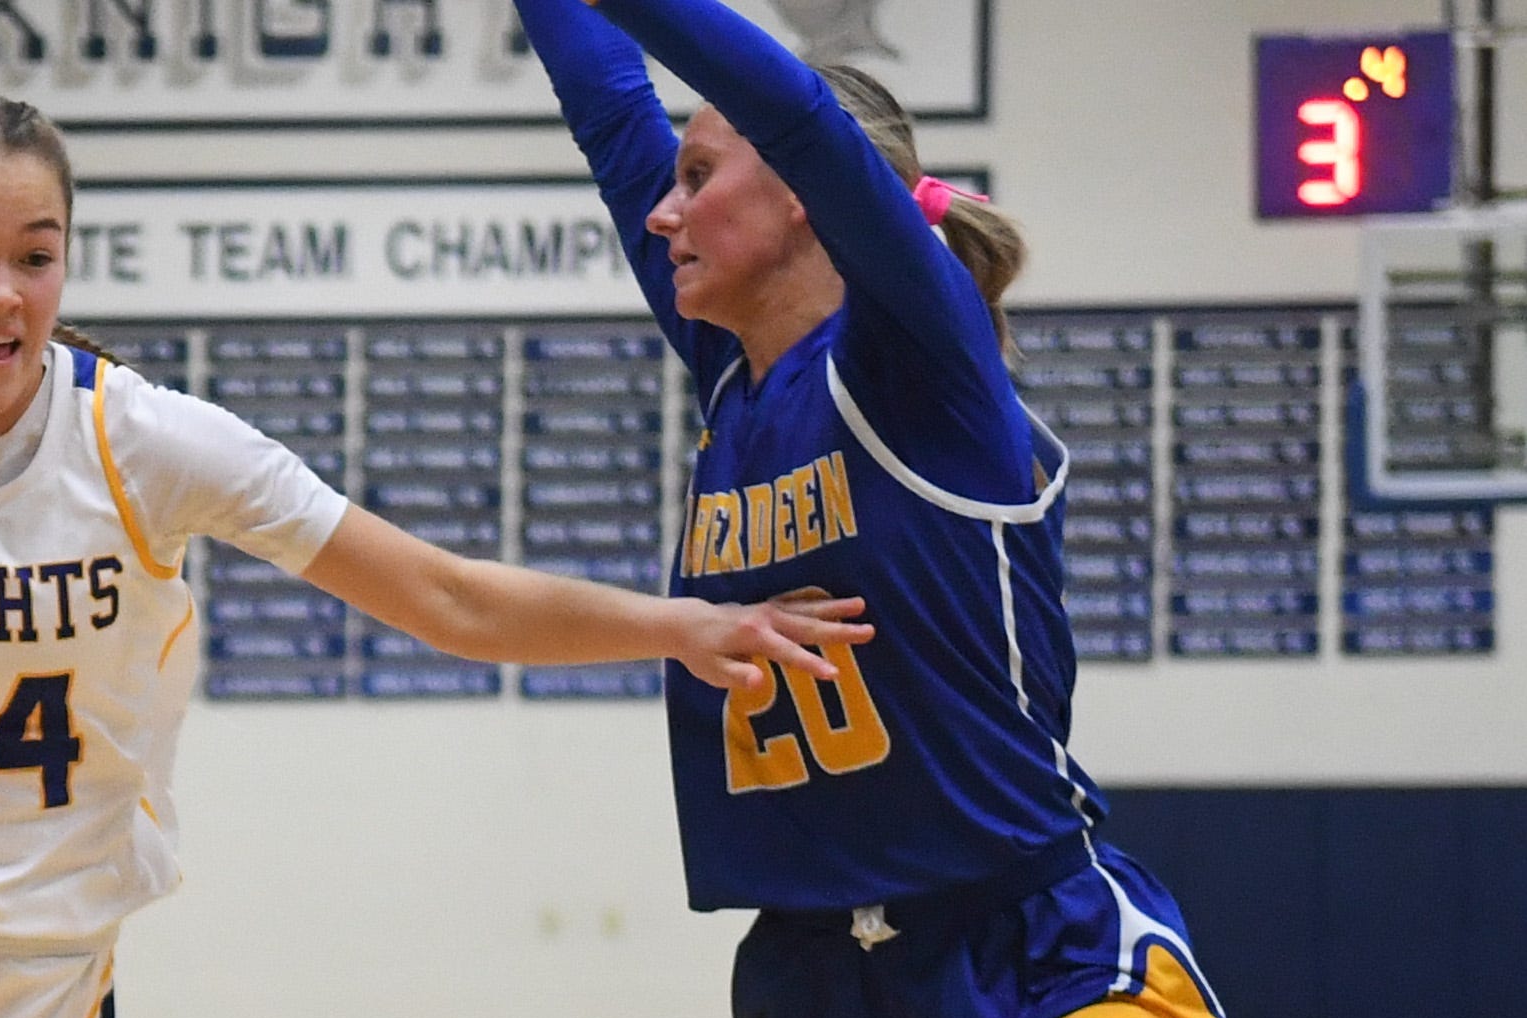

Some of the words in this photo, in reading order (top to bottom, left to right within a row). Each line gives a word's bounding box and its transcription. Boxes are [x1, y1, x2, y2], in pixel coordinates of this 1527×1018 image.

[73, 222, 142, 283] TE
[177, 220, 349, 282] TEAM
[722, 586, 891, 795] 20
